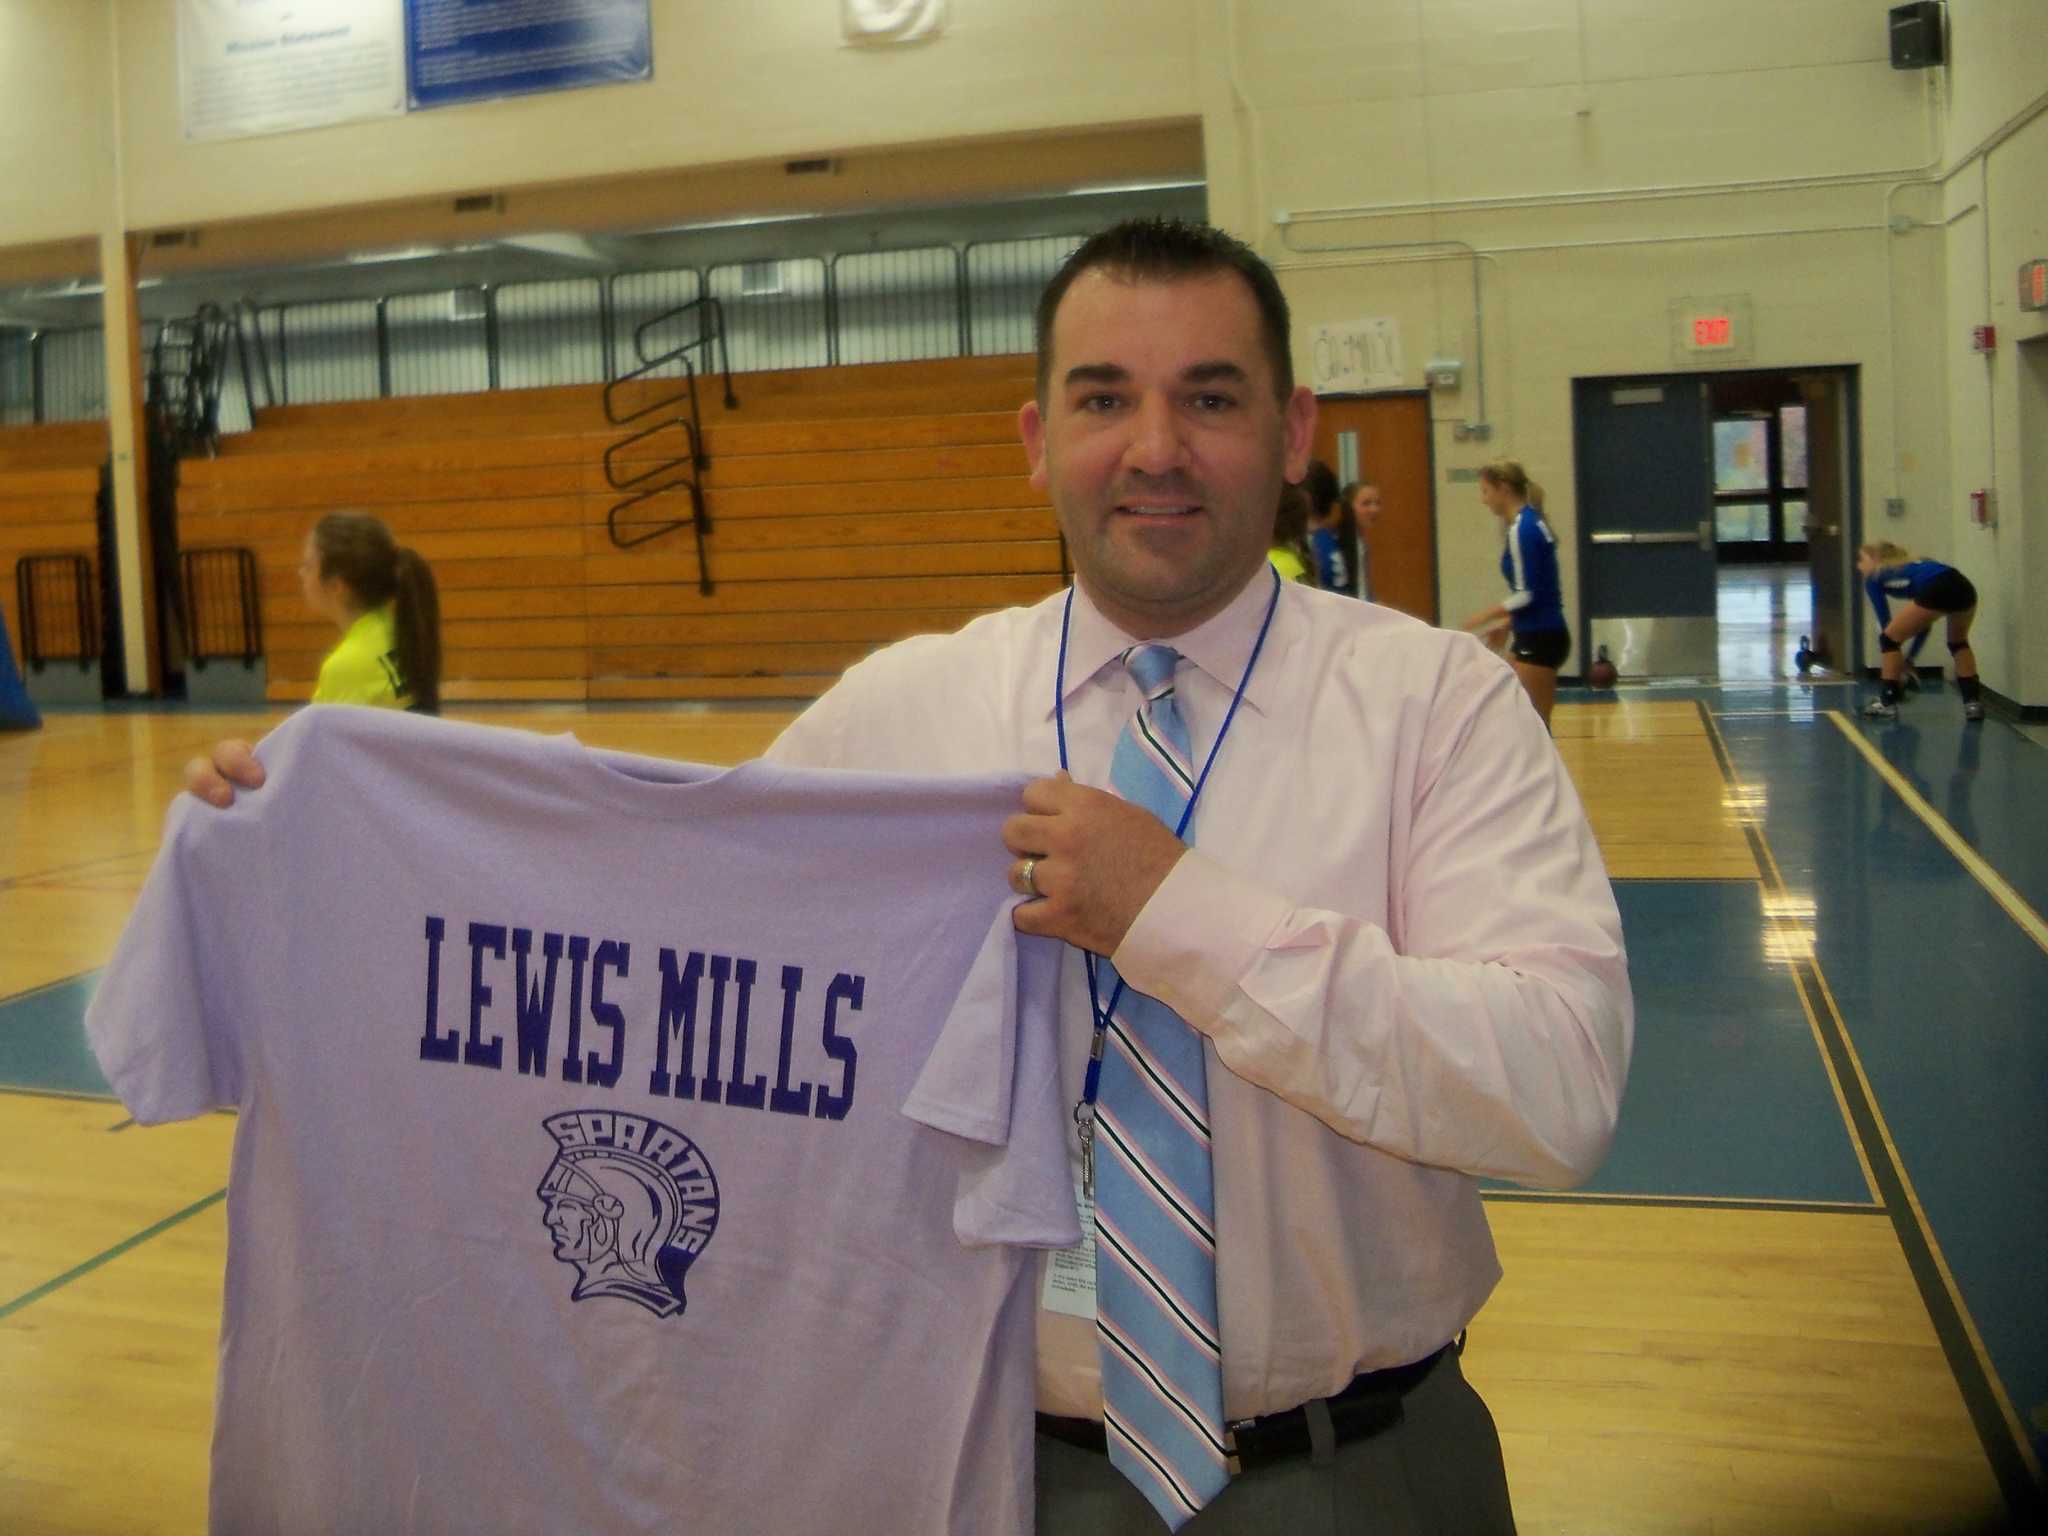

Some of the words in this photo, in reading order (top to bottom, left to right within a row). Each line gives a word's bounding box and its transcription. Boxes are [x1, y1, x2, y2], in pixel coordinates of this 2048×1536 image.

[1695, 318, 1729, 346] EXIT
[420, 916, 631, 1088] LEWIS
[649, 947, 866, 1121] MILLS
[547, 1112, 717, 1254] SPARTANS
